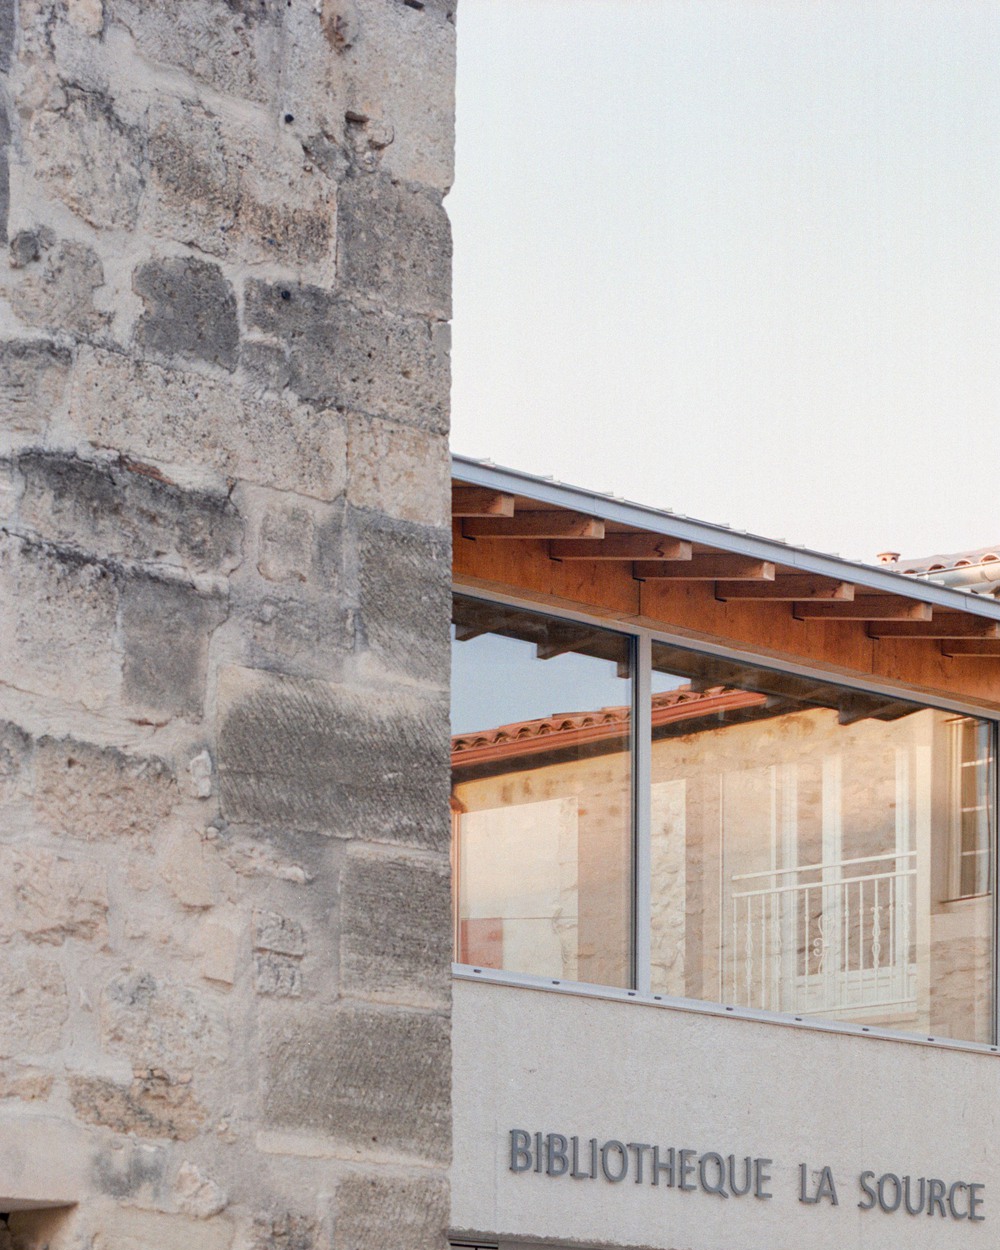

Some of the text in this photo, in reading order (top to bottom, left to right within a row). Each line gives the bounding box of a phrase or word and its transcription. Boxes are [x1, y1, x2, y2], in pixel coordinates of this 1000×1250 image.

[509, 1129, 986, 1221] BIBLIOTHEQUE LA SOURCE
